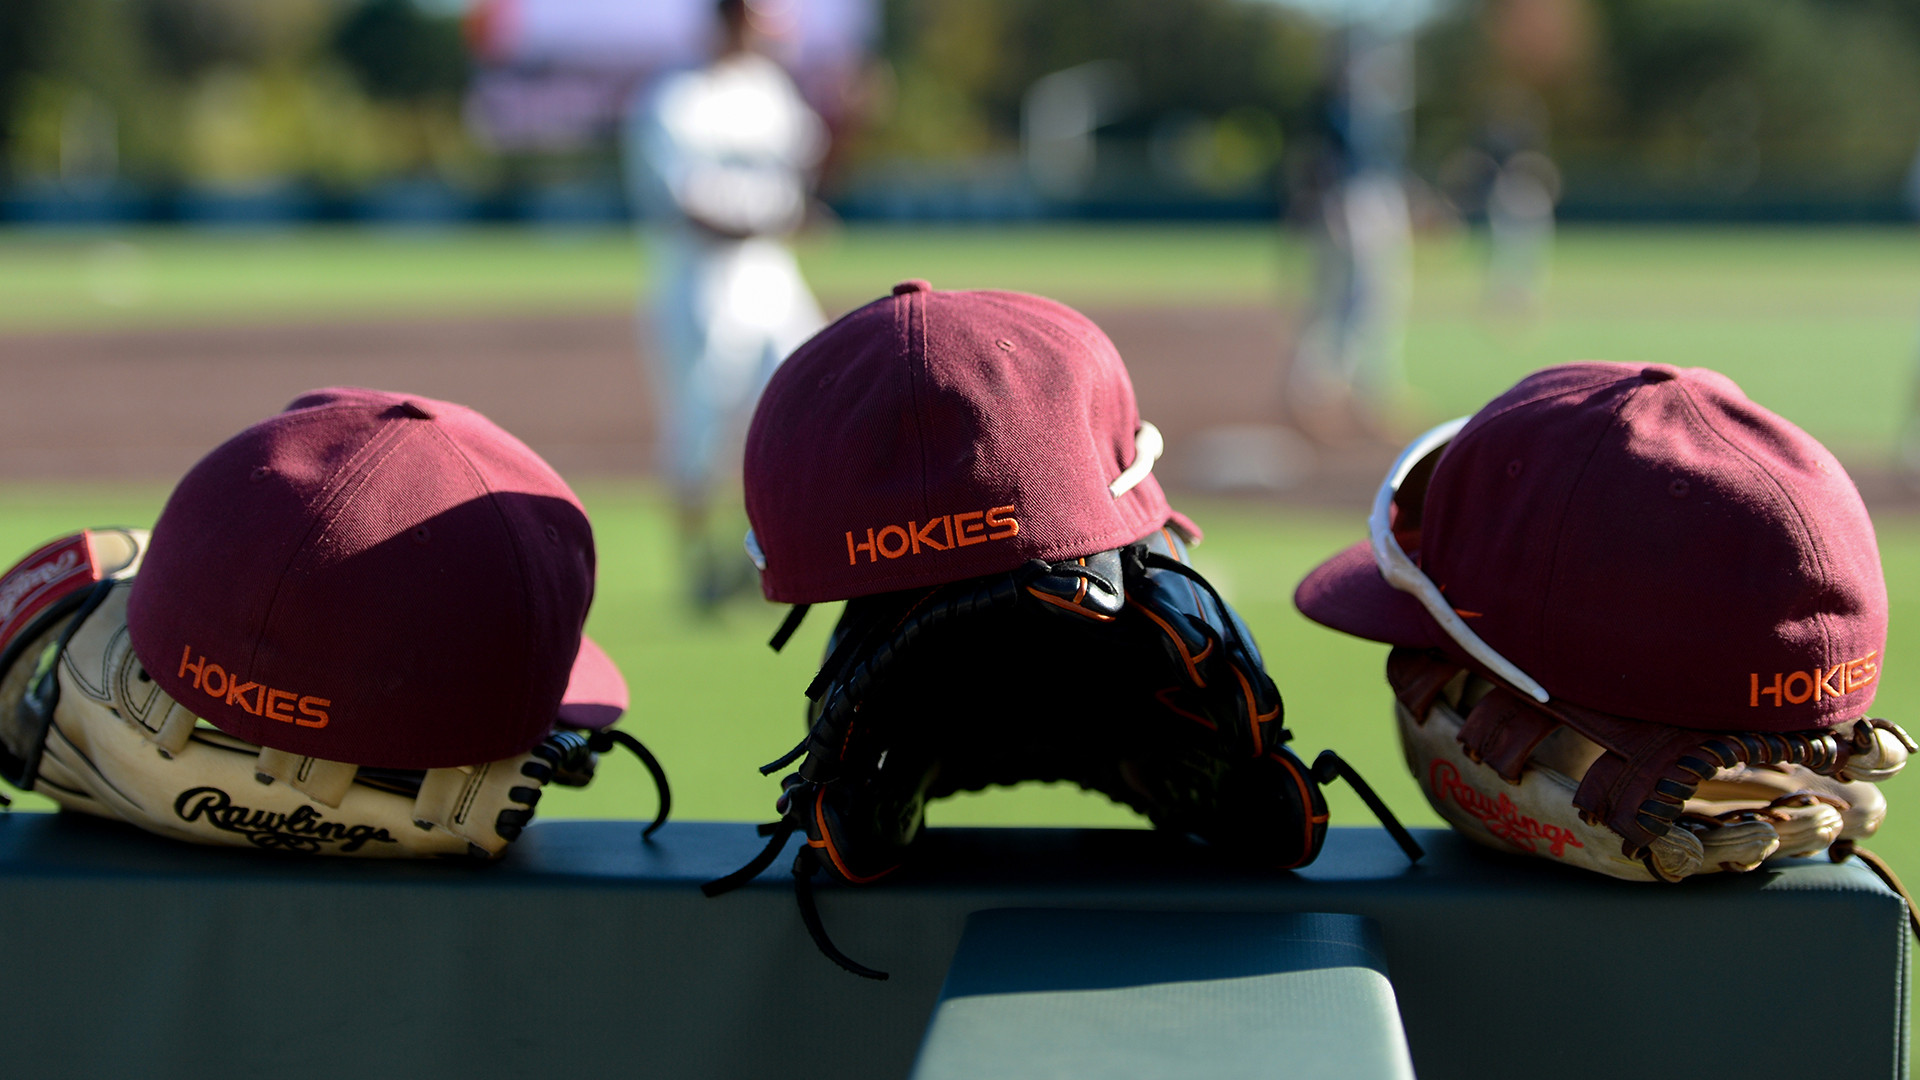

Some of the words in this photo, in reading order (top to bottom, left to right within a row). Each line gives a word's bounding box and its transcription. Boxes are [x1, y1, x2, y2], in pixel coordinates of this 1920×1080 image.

[847, 504, 1020, 566] HOKIES
[179, 644, 332, 729] HOKIES
[1750, 650, 1879, 708] HOKIES
[174, 786, 398, 852] Rawlings
[1429, 758, 1584, 858] Rawlings
